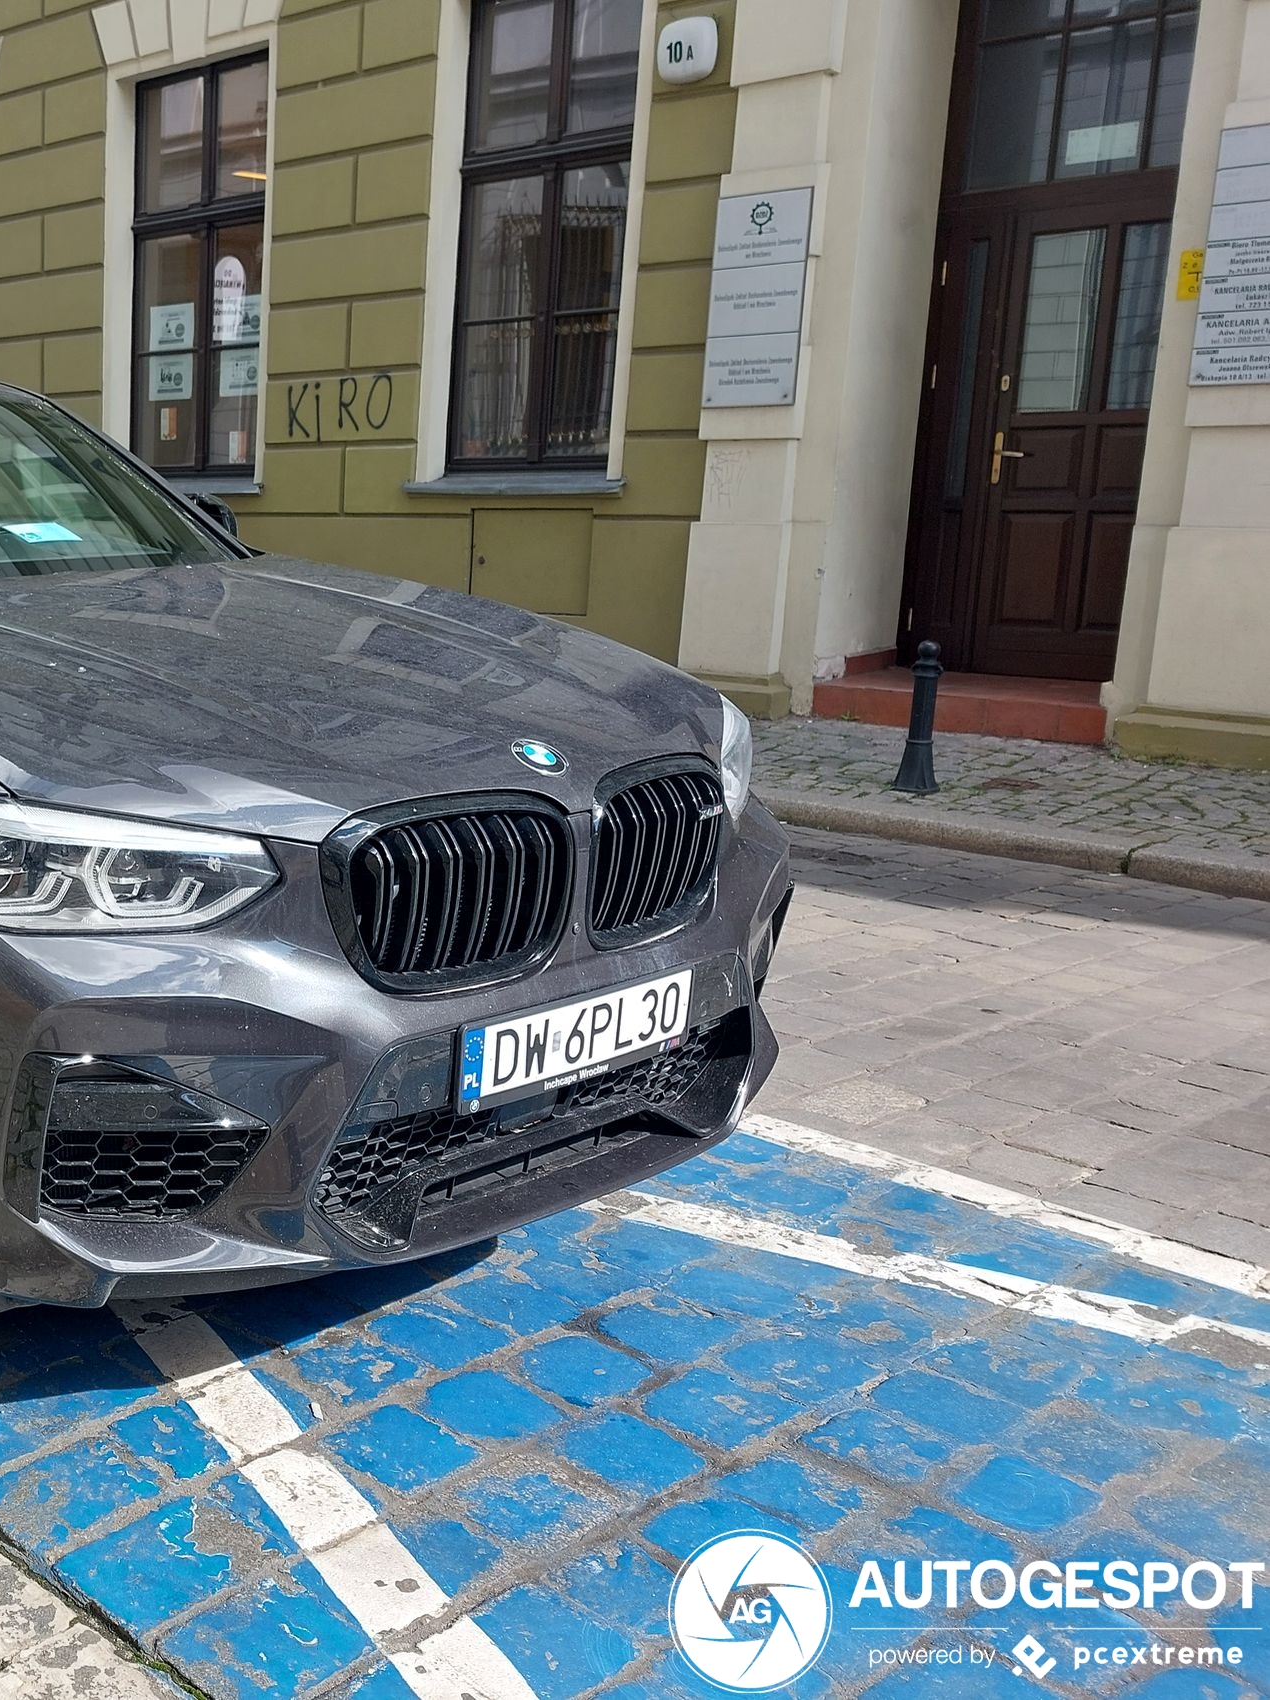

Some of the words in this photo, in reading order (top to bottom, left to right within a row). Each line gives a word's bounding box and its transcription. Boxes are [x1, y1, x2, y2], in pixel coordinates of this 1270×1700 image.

[666, 40, 682, 64] 10
[686, 44, 694, 61] A
[493, 1018, 550, 1087] DW
[565, 982, 680, 1064] 6PL30
[463, 1073, 479, 1091] PL
[544, 1074, 578, 1091] Inchcape
